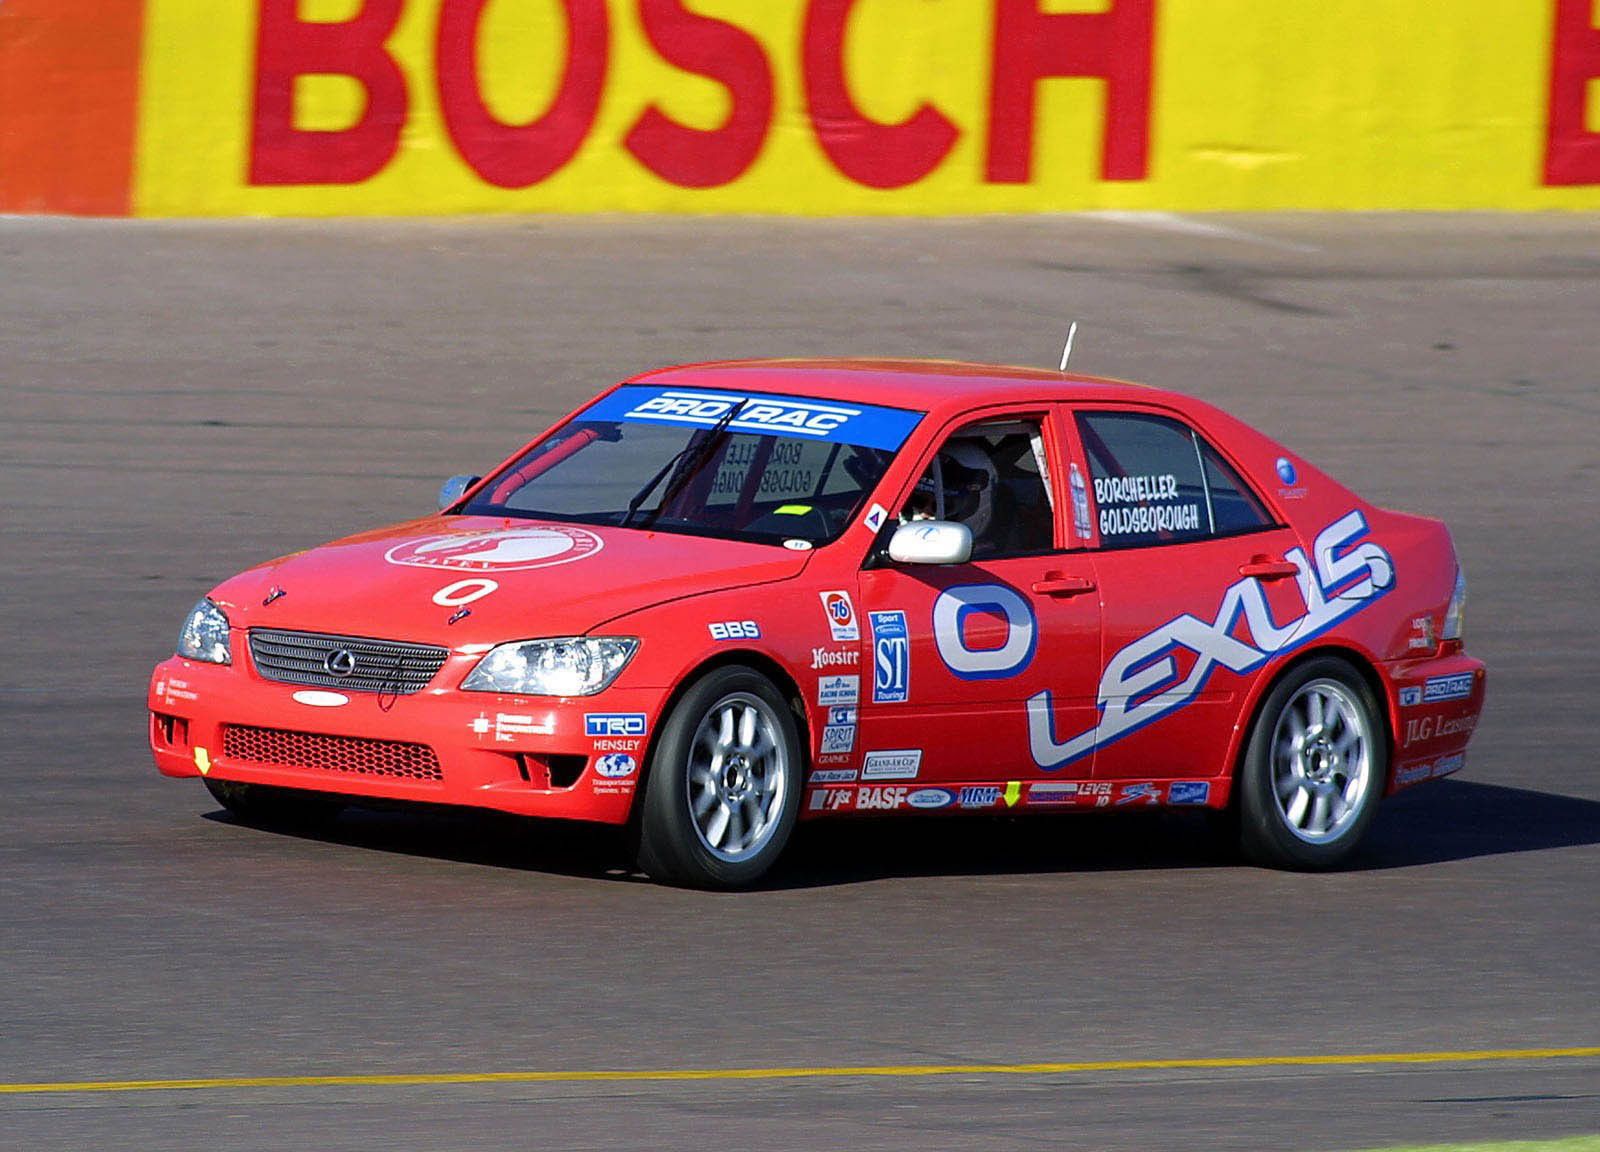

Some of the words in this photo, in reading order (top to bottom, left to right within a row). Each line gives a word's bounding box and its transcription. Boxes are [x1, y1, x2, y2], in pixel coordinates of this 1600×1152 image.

[247, 0, 1155, 188] BOSCH
[1094, 474, 1178, 504] BORCHELLER
[1100, 504, 1199, 535] GOLDSBOROUGH
[830, 599, 850, 619] 76
[877, 613, 900, 624] Sport
[707, 620, 761, 641] BBS
[1027, 509, 1397, 772] LEXUS
[810, 645, 860, 670] Hoosier
[876, 637, 906, 689] ST
[587, 717, 645, 735] TRD
[593, 739, 640, 751] HENSLEY
[856, 786, 908, 809] BASF
[1077, 783, 1112, 795] LEVEL
